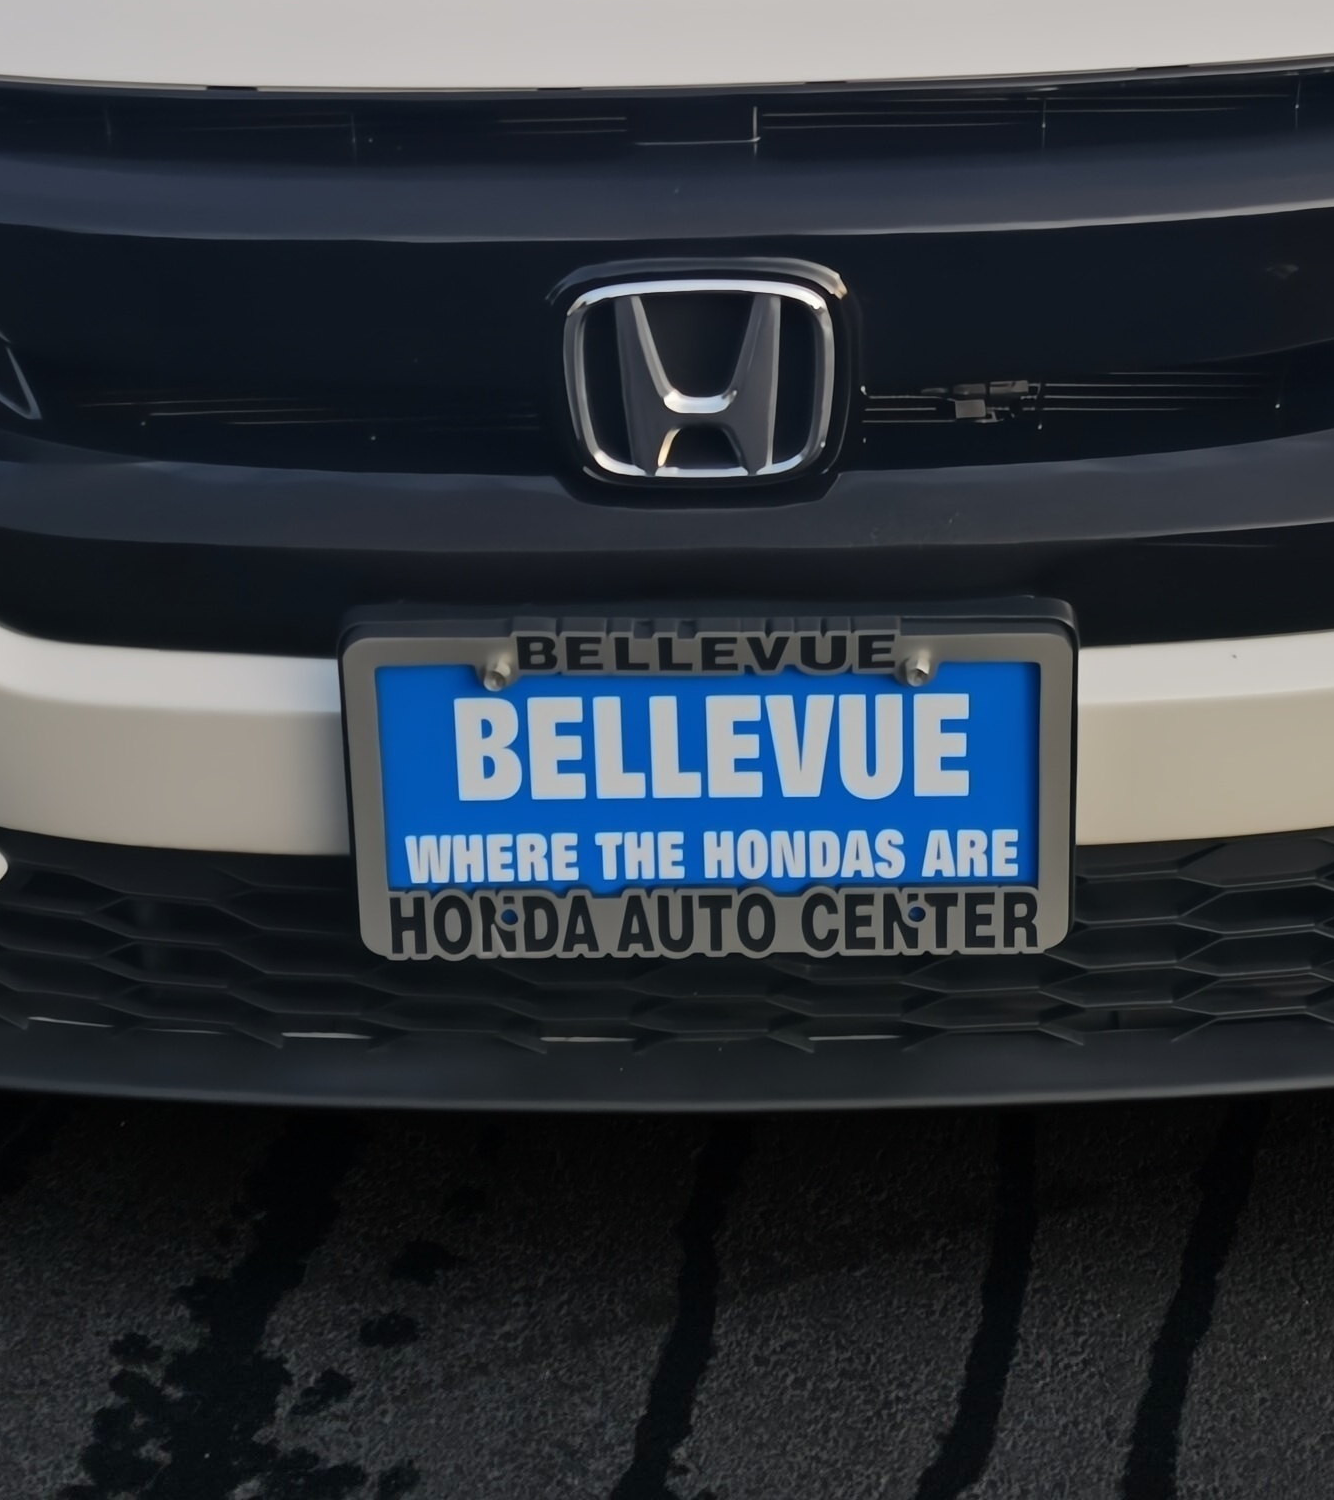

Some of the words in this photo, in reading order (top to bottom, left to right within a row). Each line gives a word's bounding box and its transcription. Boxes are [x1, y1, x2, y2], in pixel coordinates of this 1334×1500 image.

[516, 633, 897, 672] BELLEVUE
[453, 693, 969, 801] BELLEVUE
[405, 832, 579, 884] WHERE
[595, 831, 685, 881] THE
[703, 829, 905, 880] HONDAS
[921, 829, 1019, 878] ARE
[389, 894, 599, 955] HONDA
[617, 893, 776, 953] AUTO
[801, 891, 1038, 952] CENTER
